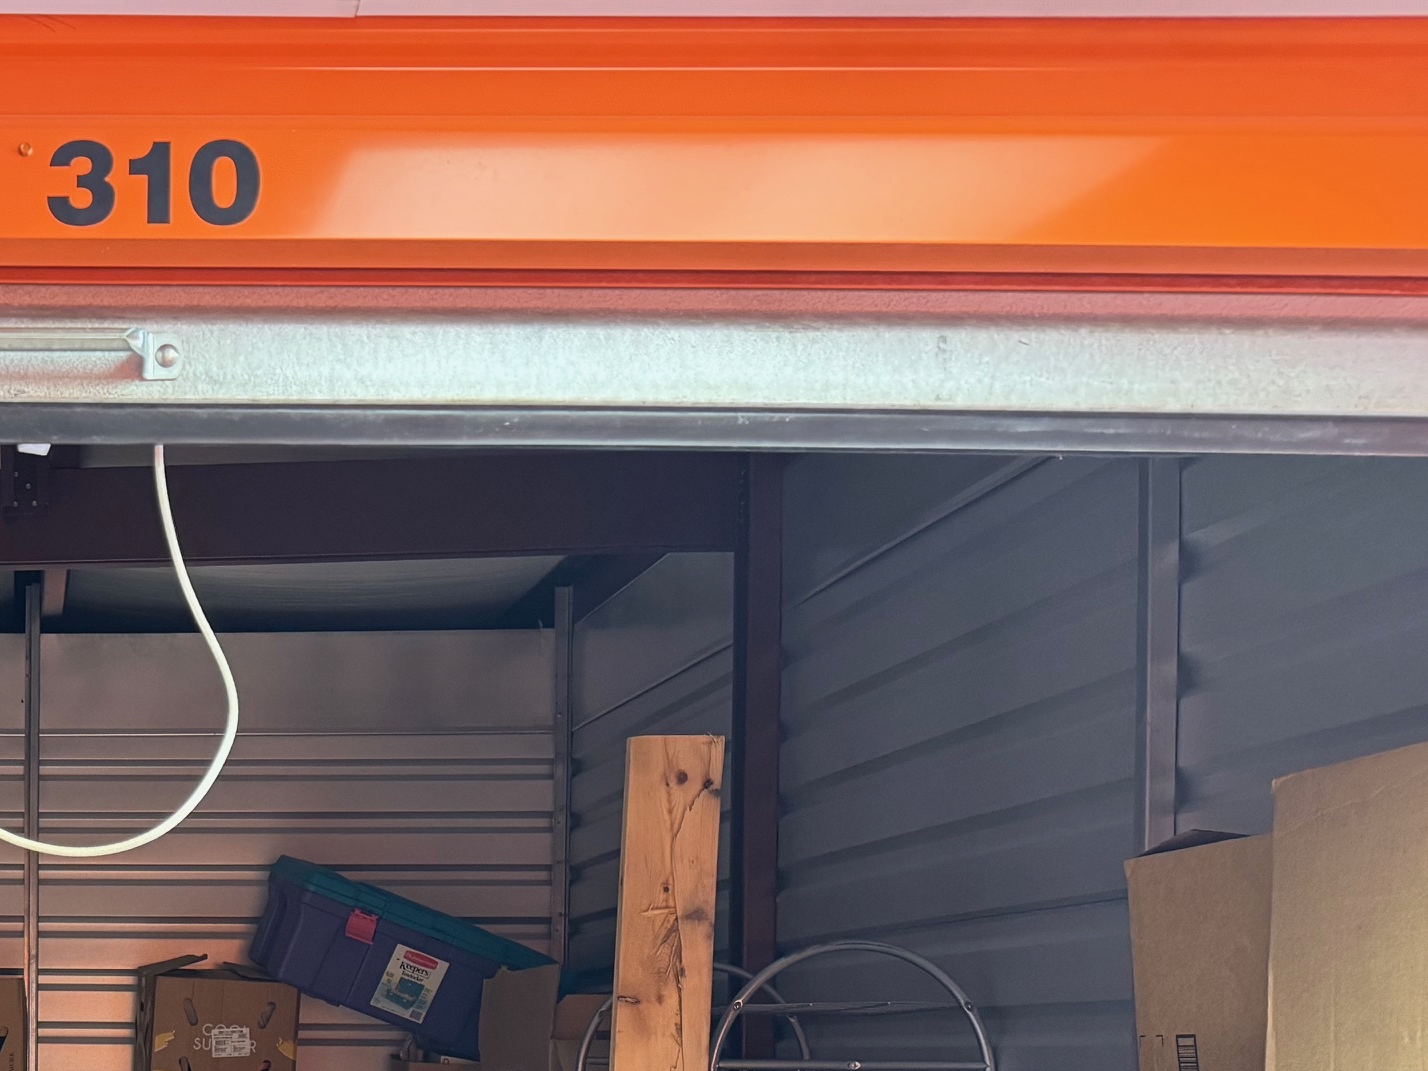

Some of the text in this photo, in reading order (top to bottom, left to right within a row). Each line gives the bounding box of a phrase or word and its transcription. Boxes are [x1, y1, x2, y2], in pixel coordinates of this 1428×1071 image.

[47, 139, 261, 226] 310
[400, 961, 429, 976] Keepers
[193, 1037, 256, 1053] SUR
